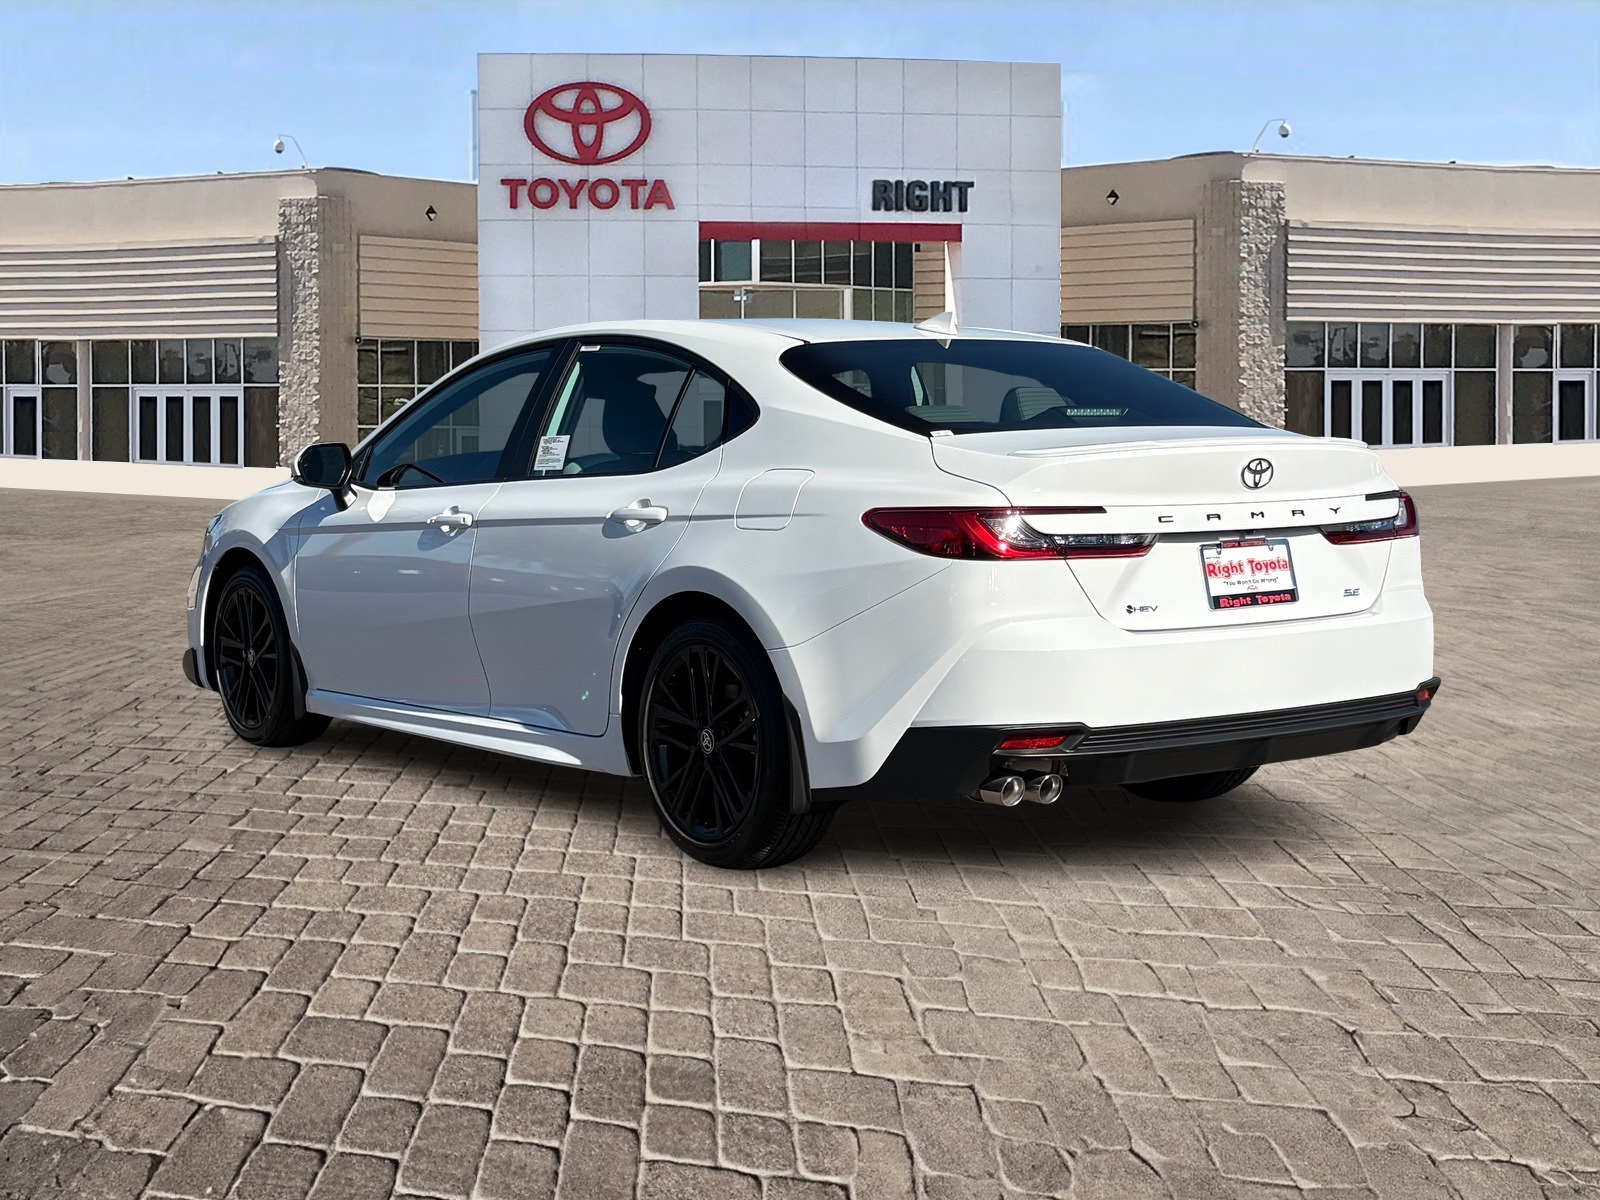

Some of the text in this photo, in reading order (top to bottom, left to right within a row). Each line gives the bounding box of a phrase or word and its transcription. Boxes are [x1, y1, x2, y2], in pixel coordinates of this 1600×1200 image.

[500, 178, 675, 210] TOYOTA
[872, 180, 974, 213] RIGHT
[1157, 506, 1342, 524] CAMRY
[1206, 557, 1290, 578] Right Toyota
[1219, 593, 1292, 608] Right Toyota
[1343, 588, 1360, 597] SE
[1133, 605, 1158, 613] HEV
